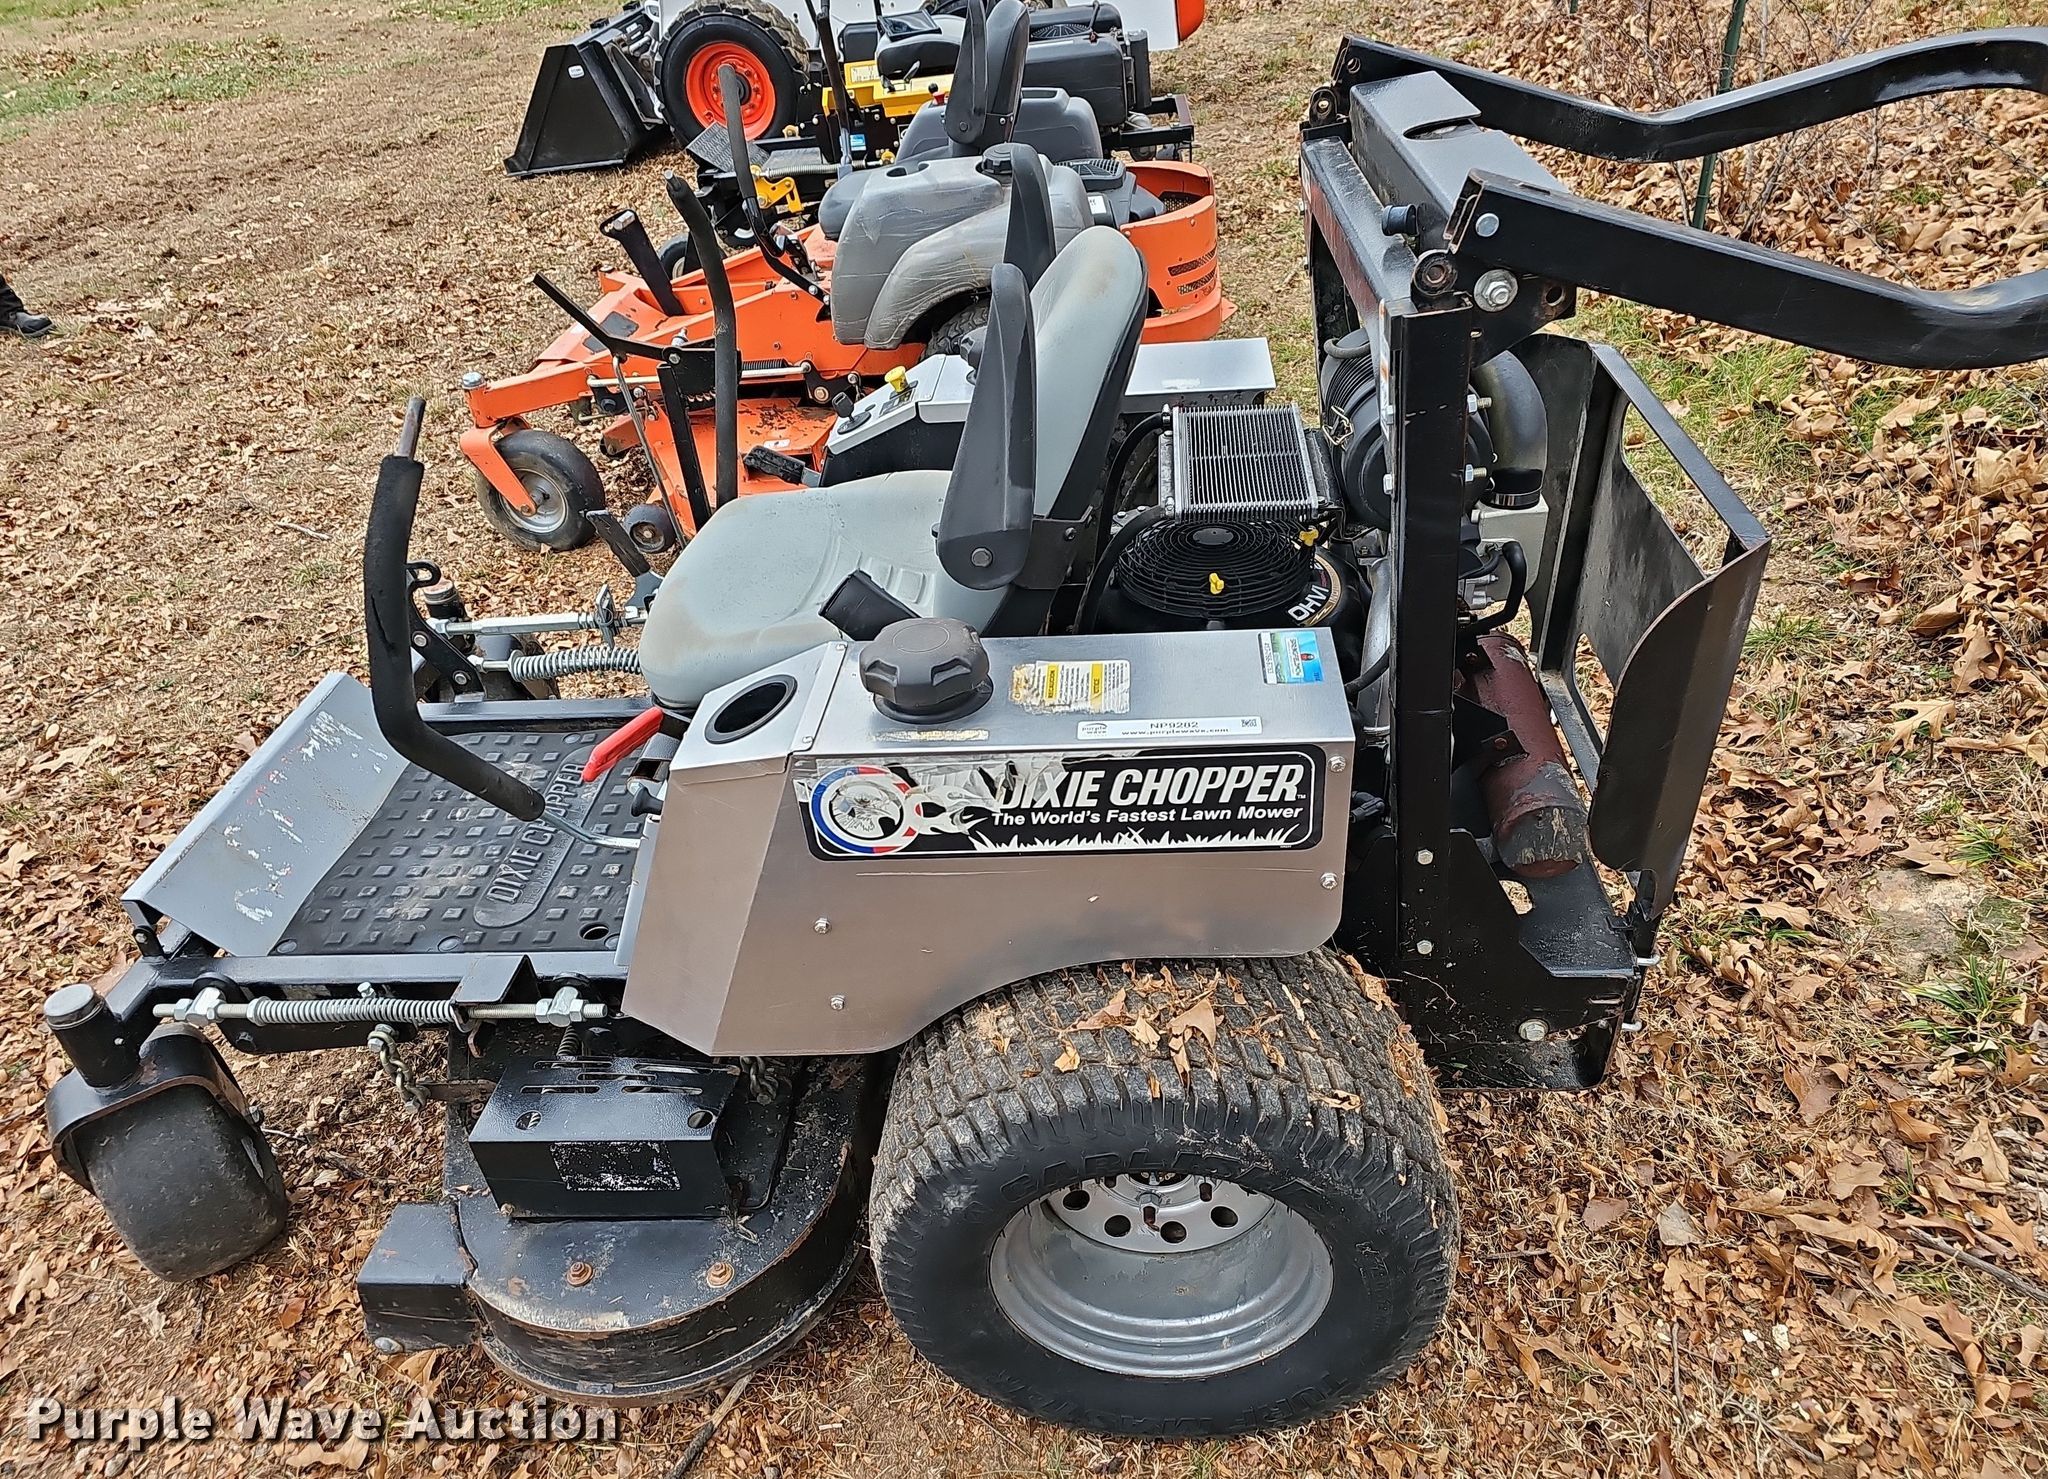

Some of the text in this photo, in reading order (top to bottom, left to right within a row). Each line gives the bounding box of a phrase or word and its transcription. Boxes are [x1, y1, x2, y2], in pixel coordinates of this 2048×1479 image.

[1288, 584, 1330, 621] OHVI
[998, 770, 1106, 809] DIXIE
[1109, 764, 1304, 807] CHOPPER
[991, 805, 1304, 826] The World's Fastest Lawn Mower
[486, 848, 544, 905] DIXIE
